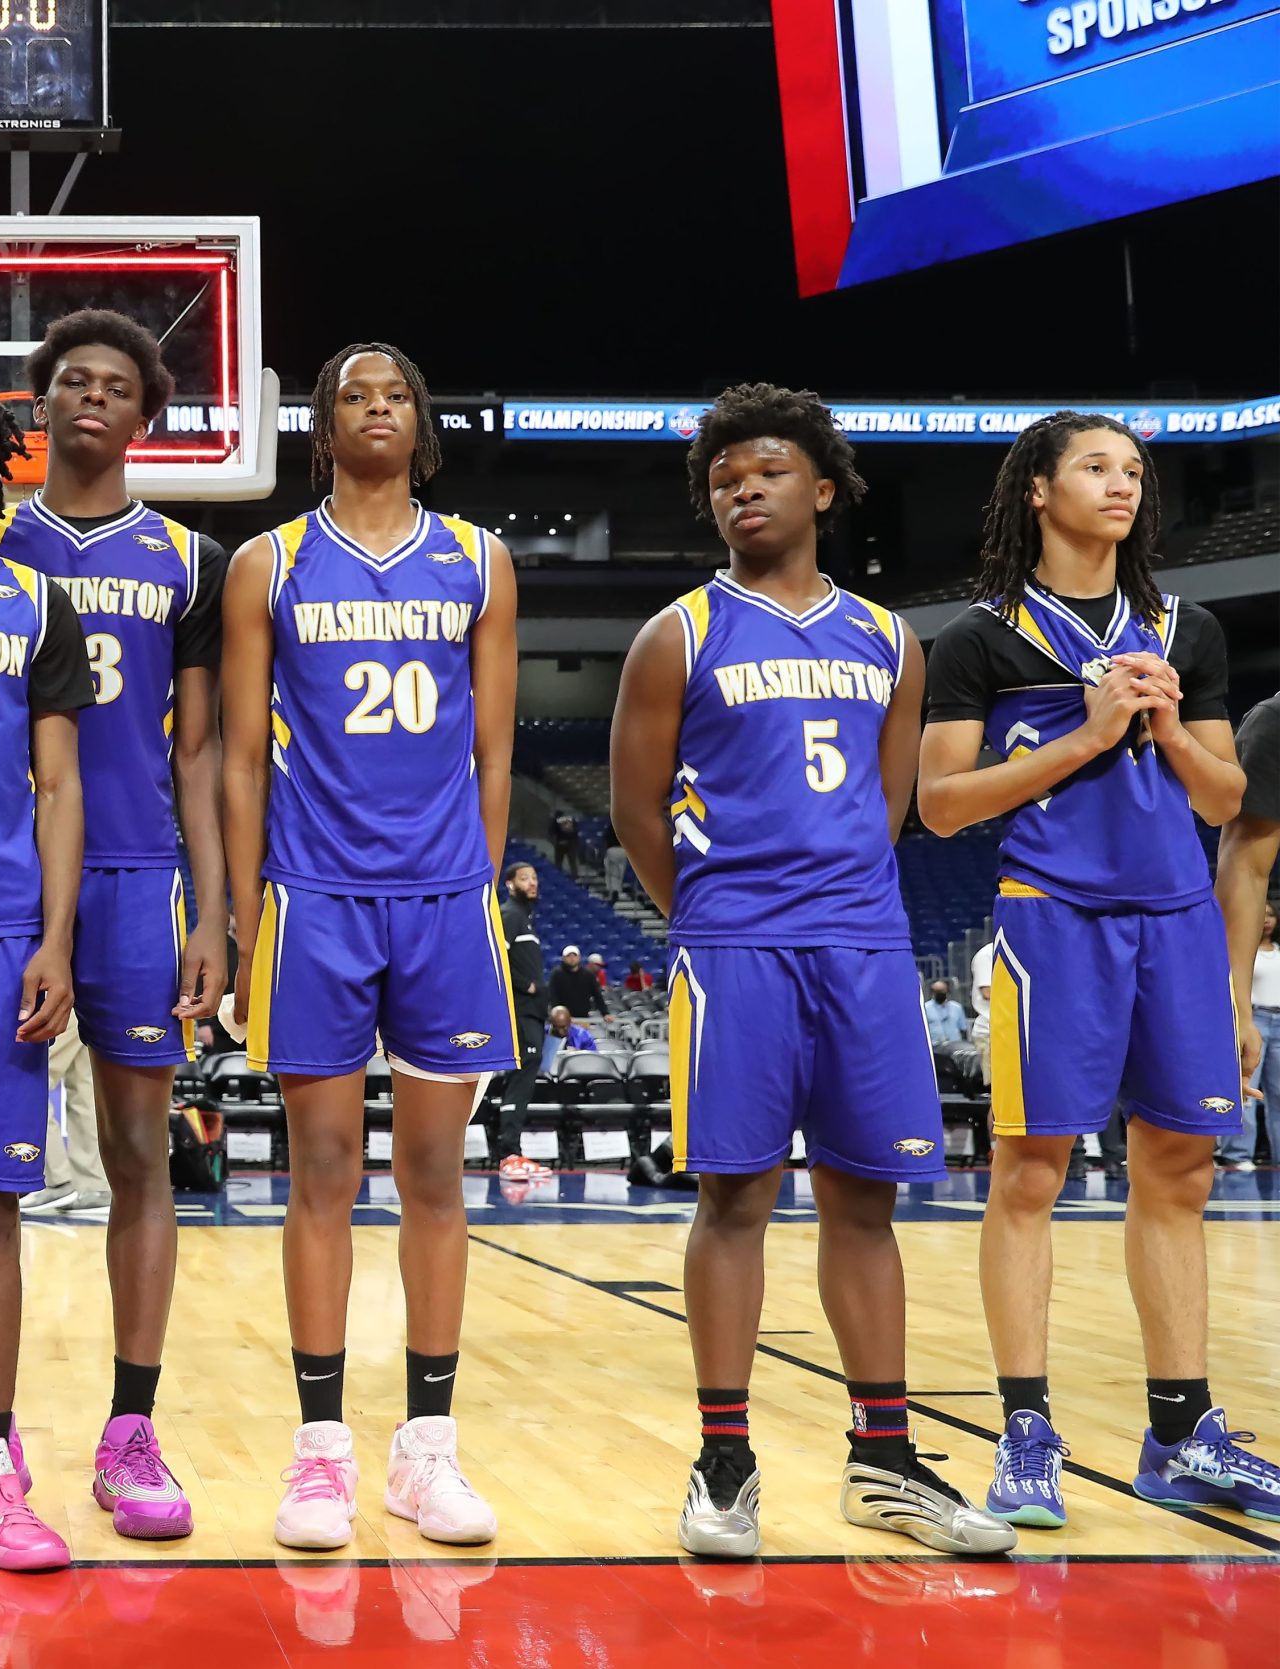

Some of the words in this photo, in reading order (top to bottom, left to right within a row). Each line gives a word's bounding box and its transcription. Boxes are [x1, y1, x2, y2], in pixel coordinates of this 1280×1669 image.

[166, 405, 208, 432] HOU.
[439, 414, 472, 430] TOL
[479, 408, 494, 432] 1
[518, 410, 665, 430] CHAMPIONSHIPS
[830, 412, 923, 432] SKETBALL
[926, 412, 977, 433] STATE
[1167, 412, 1217, 432] BOYS
[293, 599, 473, 645] WASHINGTON
[343, 660, 439, 735] 20
[802, 718, 847, 793] 5
